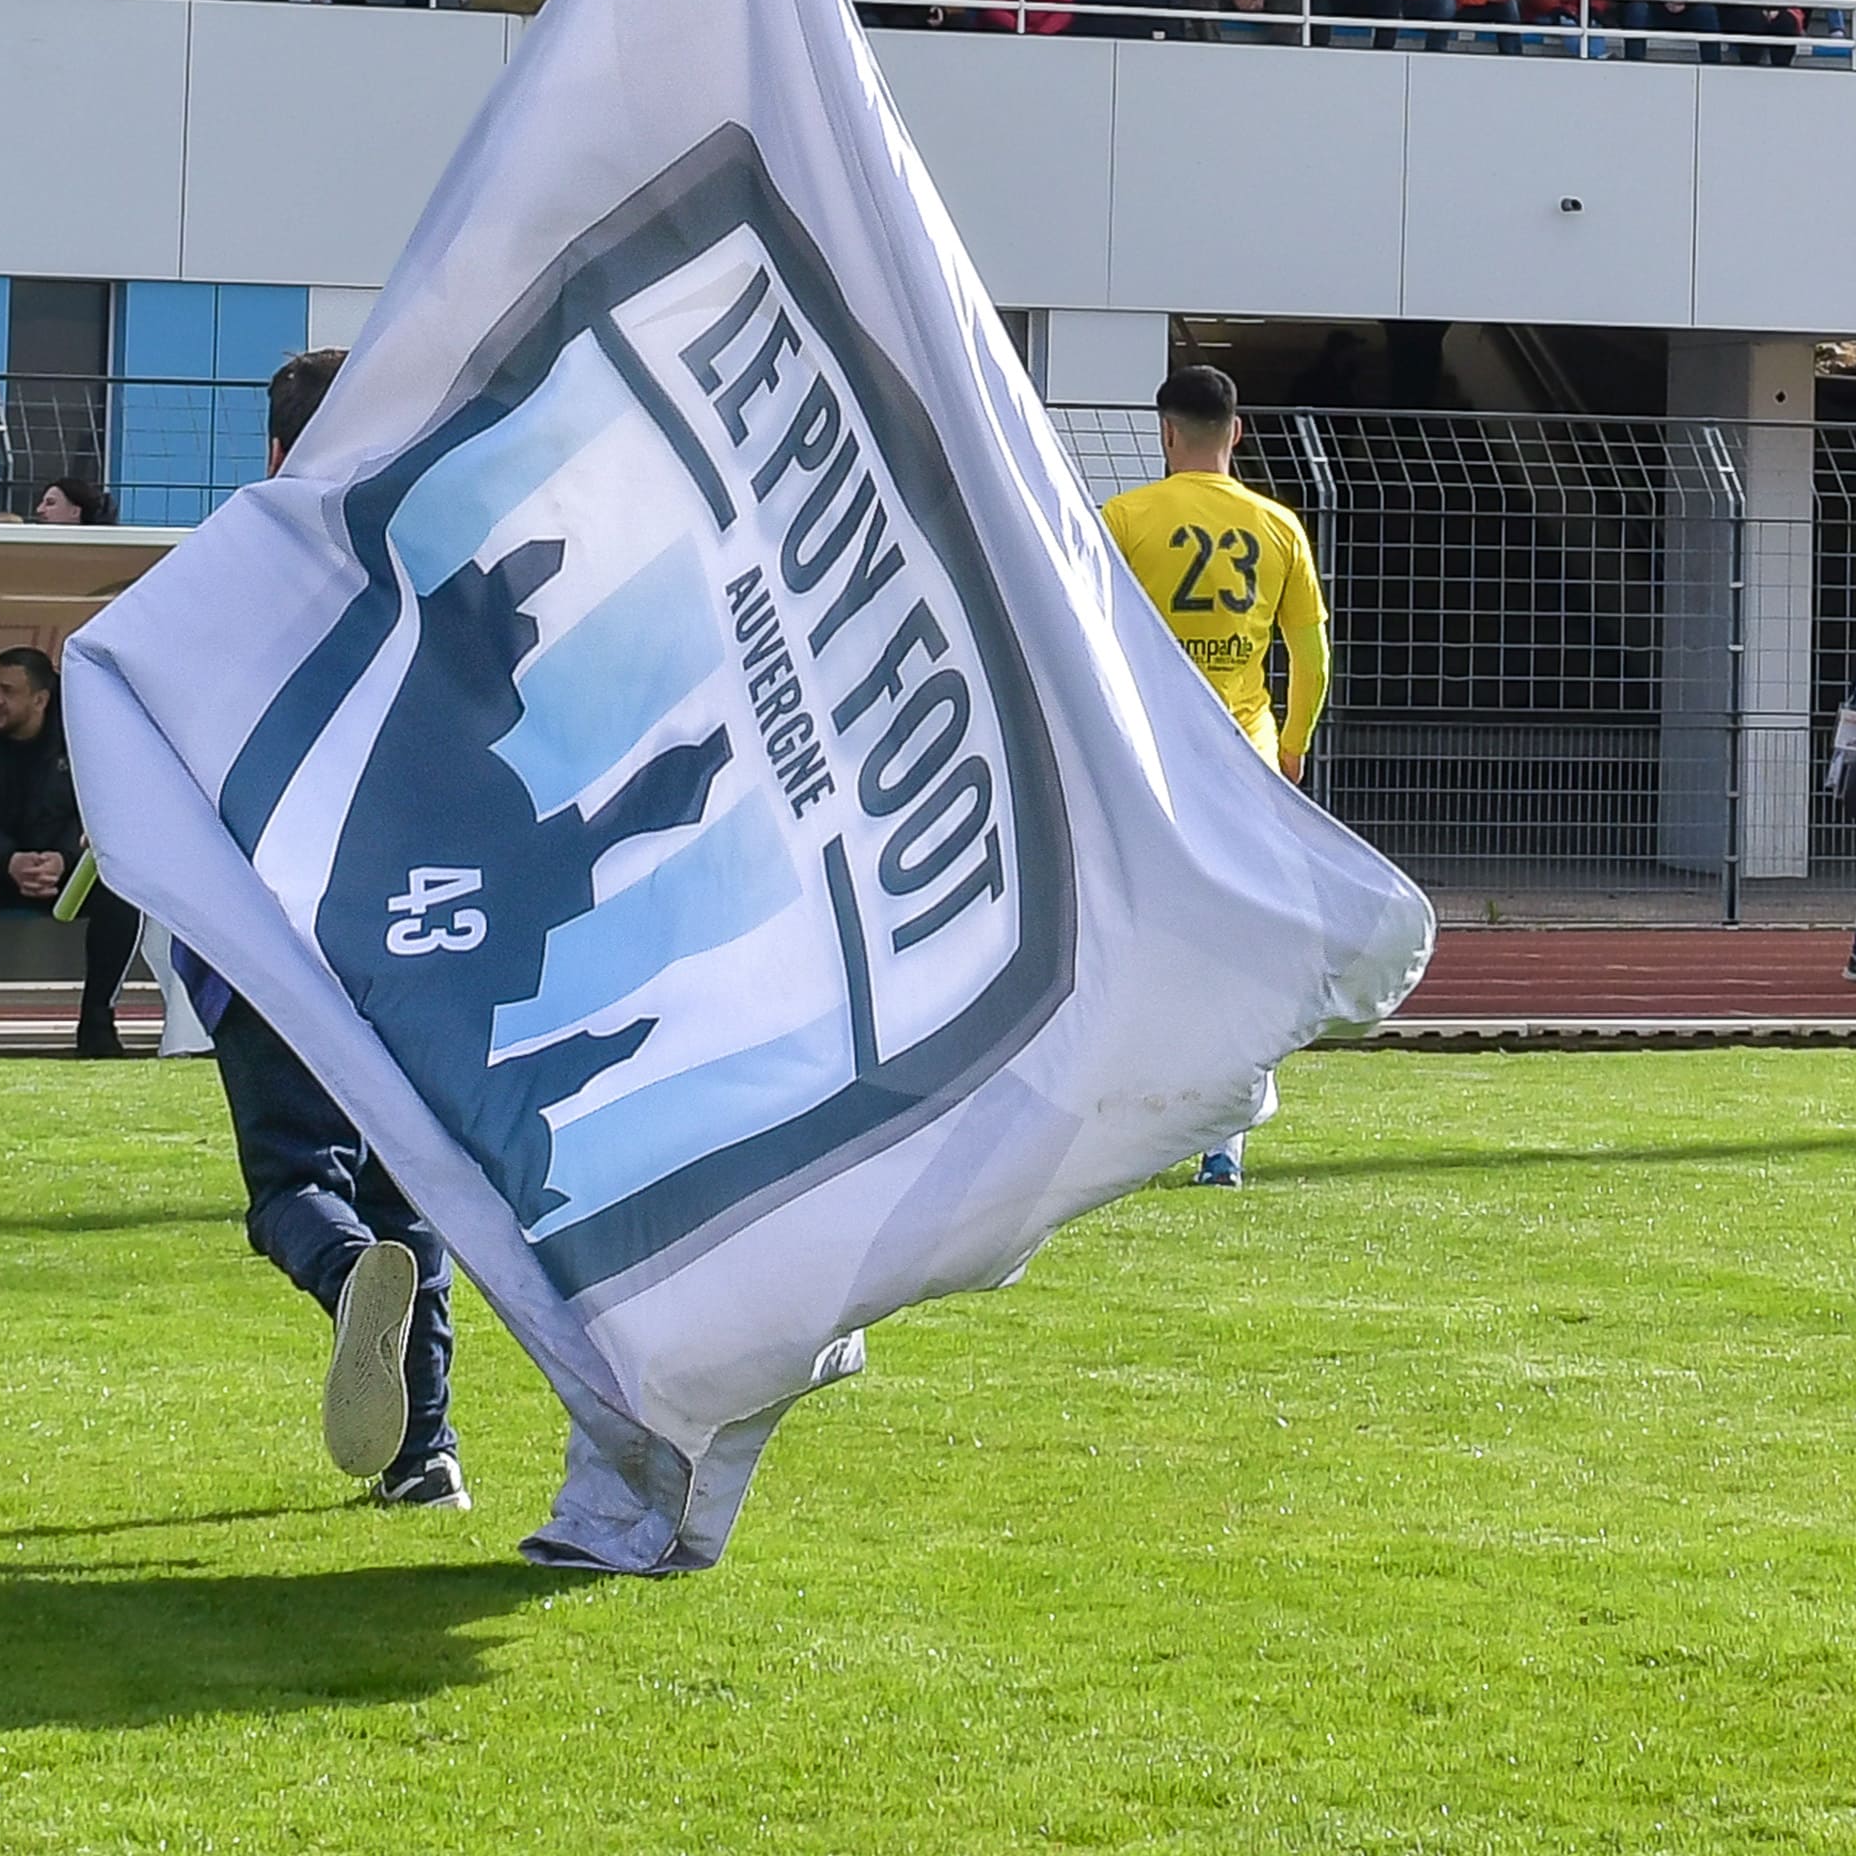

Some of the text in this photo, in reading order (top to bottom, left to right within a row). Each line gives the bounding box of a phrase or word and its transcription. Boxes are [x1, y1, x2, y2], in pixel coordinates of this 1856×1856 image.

[678, 264, 1005, 955] LE PUY FOOT
[1170, 524, 1260, 613] 23
[725, 564, 836, 820] AUVERGNE
[386, 866, 487, 955] 43
